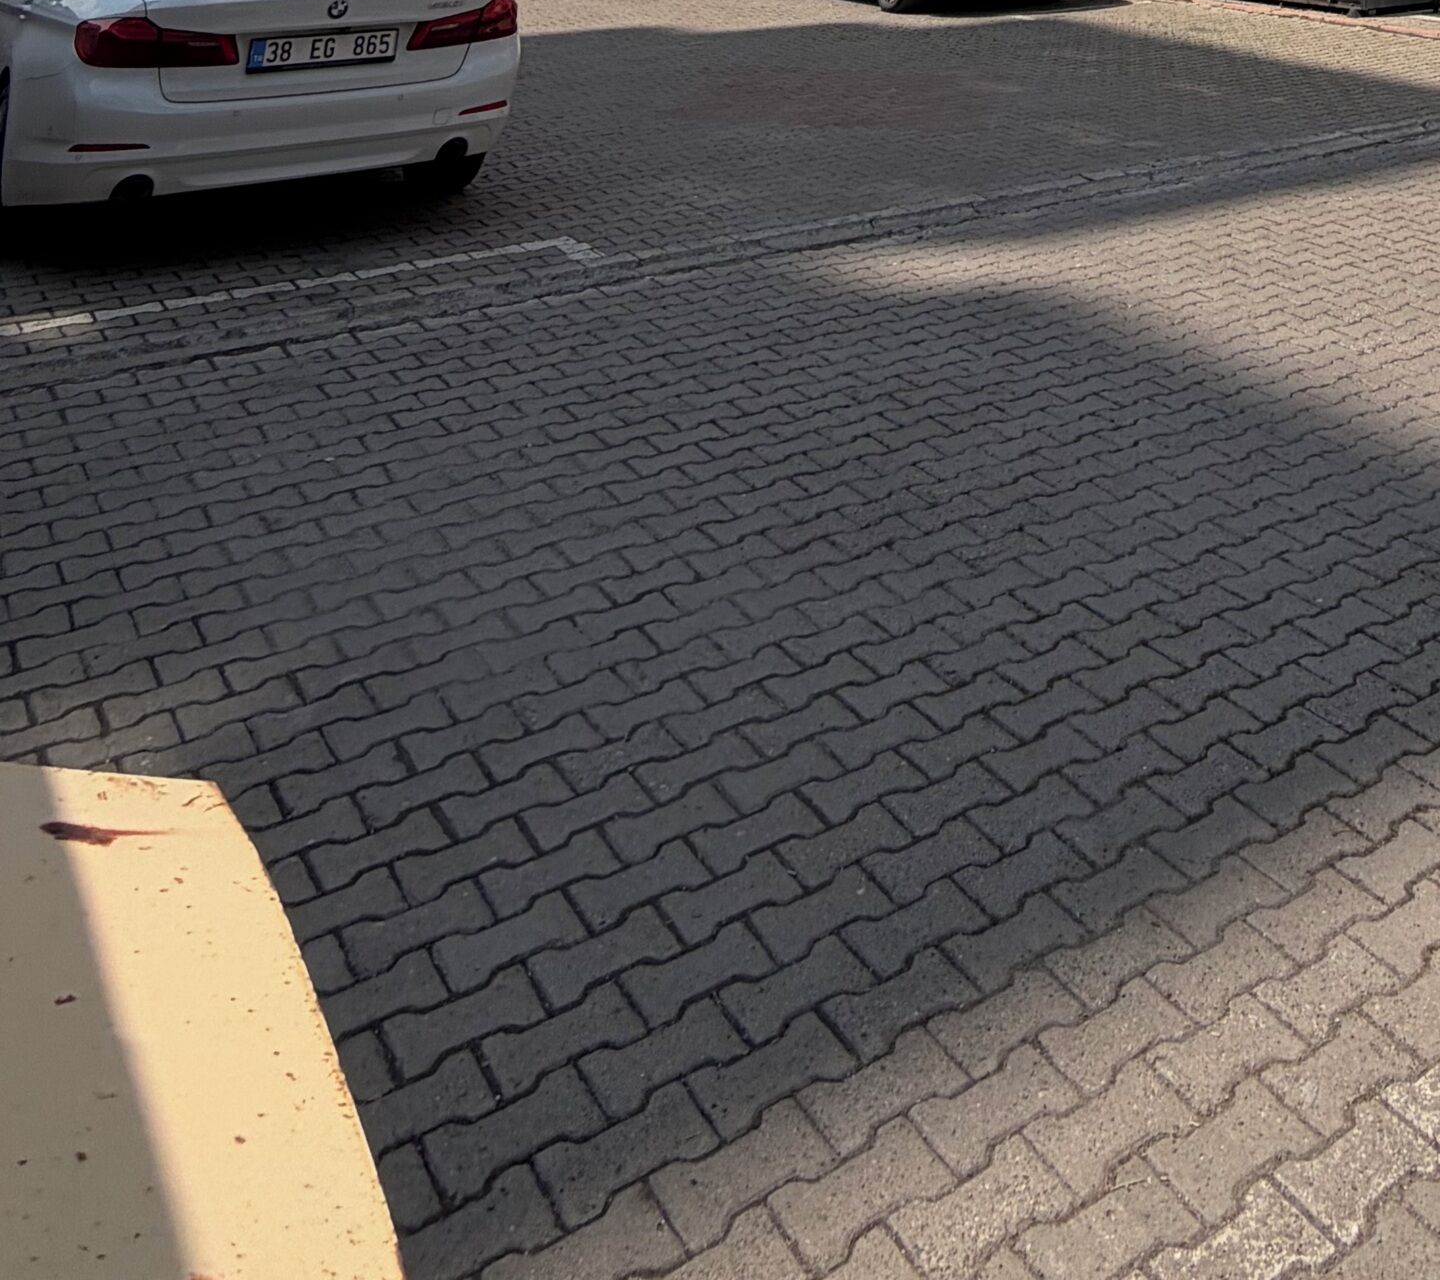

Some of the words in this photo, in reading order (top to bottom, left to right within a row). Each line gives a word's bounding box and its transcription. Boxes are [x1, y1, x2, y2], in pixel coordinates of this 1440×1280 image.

[266, 41, 292, 63] 38
[309, 38, 336, 60] EG
[353, 33, 391, 56] 865
